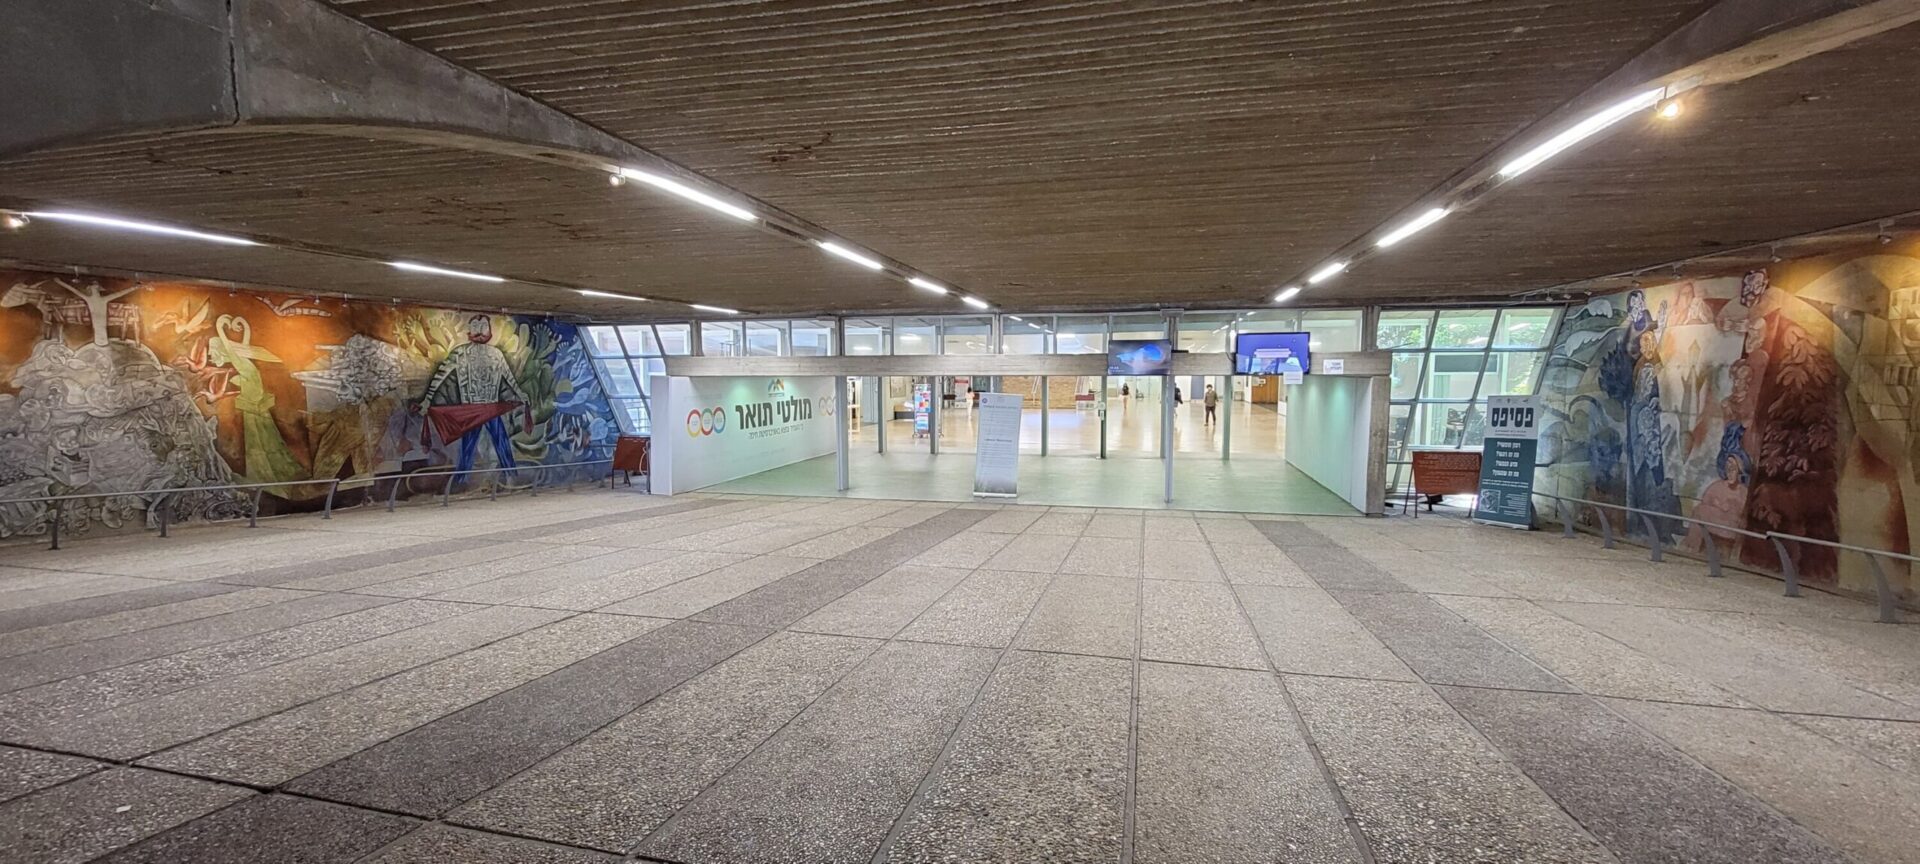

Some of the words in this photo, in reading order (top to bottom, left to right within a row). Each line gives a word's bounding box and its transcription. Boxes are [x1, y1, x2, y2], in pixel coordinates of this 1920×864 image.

[735, 401, 773, 430] תואר
[776, 395, 813, 423] מולטי
[1491, 407, 1534, 428] פסיפס
